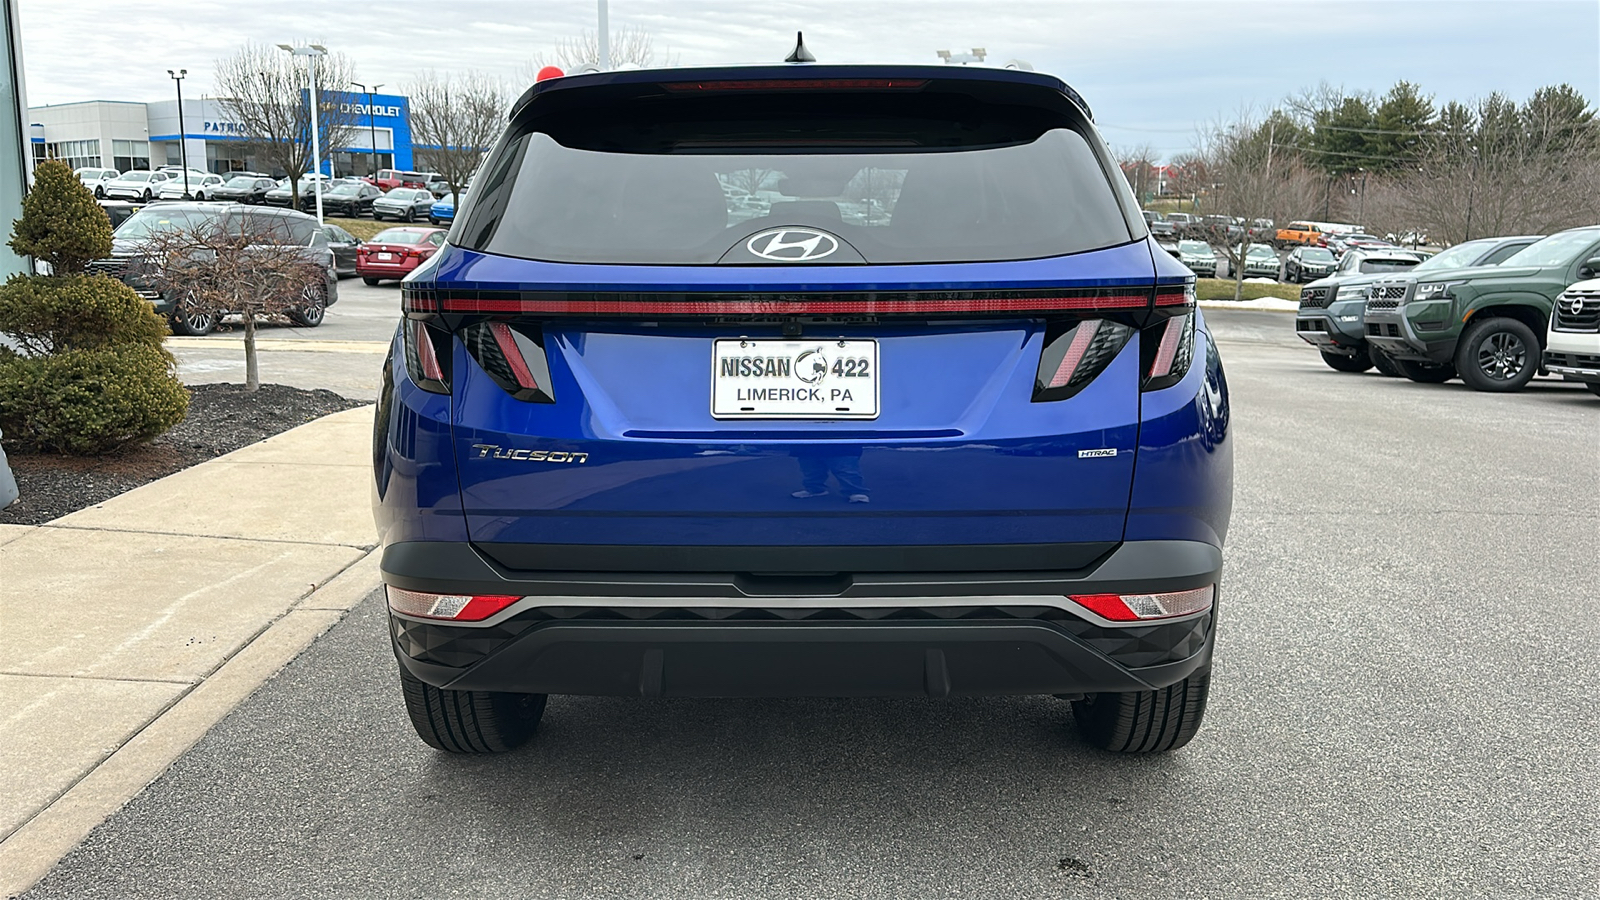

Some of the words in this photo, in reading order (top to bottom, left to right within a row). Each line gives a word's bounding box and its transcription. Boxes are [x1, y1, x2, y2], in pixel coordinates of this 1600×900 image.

[339, 102, 401, 117] CHEVROLET
[204, 121, 251, 133] PATRIO
[720, 356, 792, 378] NISSAN
[831, 356, 870, 378] 422
[737, 388, 825, 403] LIMERICK,
[830, 388, 854, 402] PA
[1081, 449, 1115, 457] HTRAC
